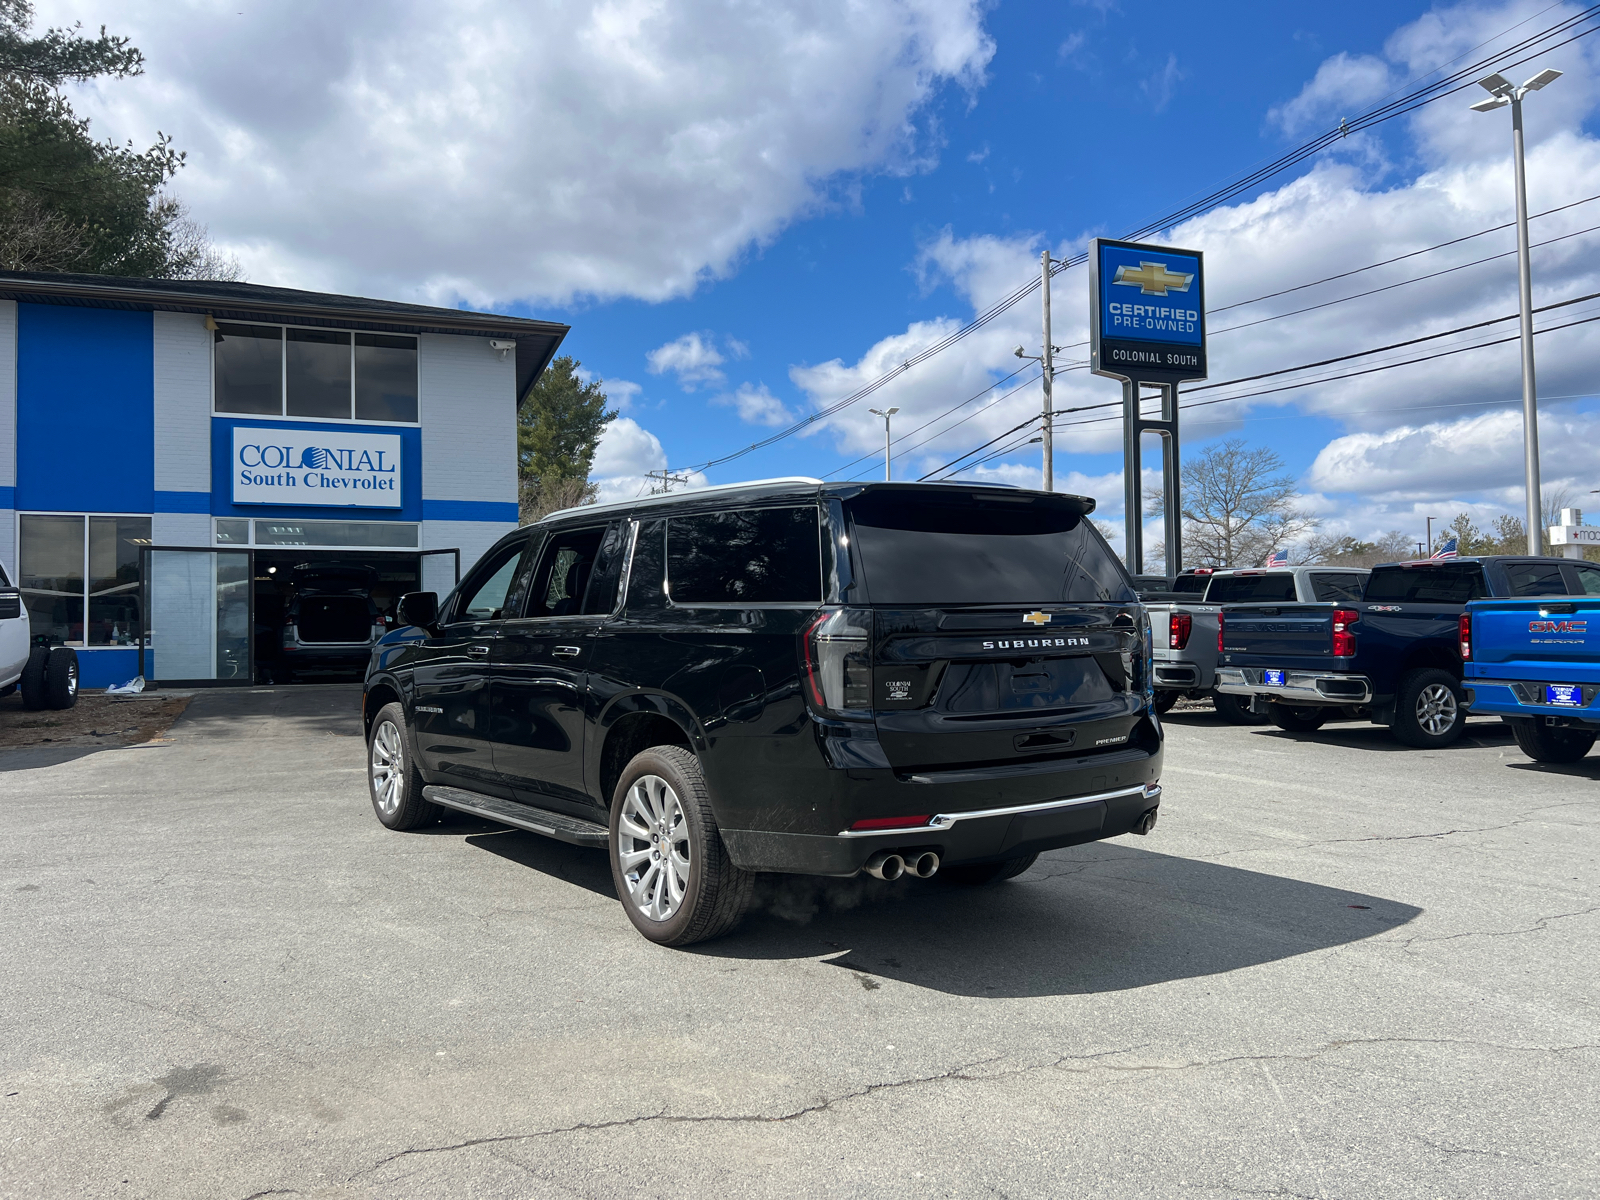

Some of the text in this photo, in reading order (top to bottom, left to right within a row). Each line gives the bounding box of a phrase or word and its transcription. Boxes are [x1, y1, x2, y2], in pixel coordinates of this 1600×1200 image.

[1109, 302, 1198, 321] CERTIFIED
[1114, 315, 1194, 333] PRE-OWNED
[1112, 349, 1198, 366] COLONIAL SOUTH
[239, 444, 395, 473] COLONIAL
[240, 470, 395, 490] South Chevrolet
[1529, 621, 1587, 633] GMC
[982, 638, 1089, 650] SUBURBAN
[1095, 735, 1127, 746] PREMIER
